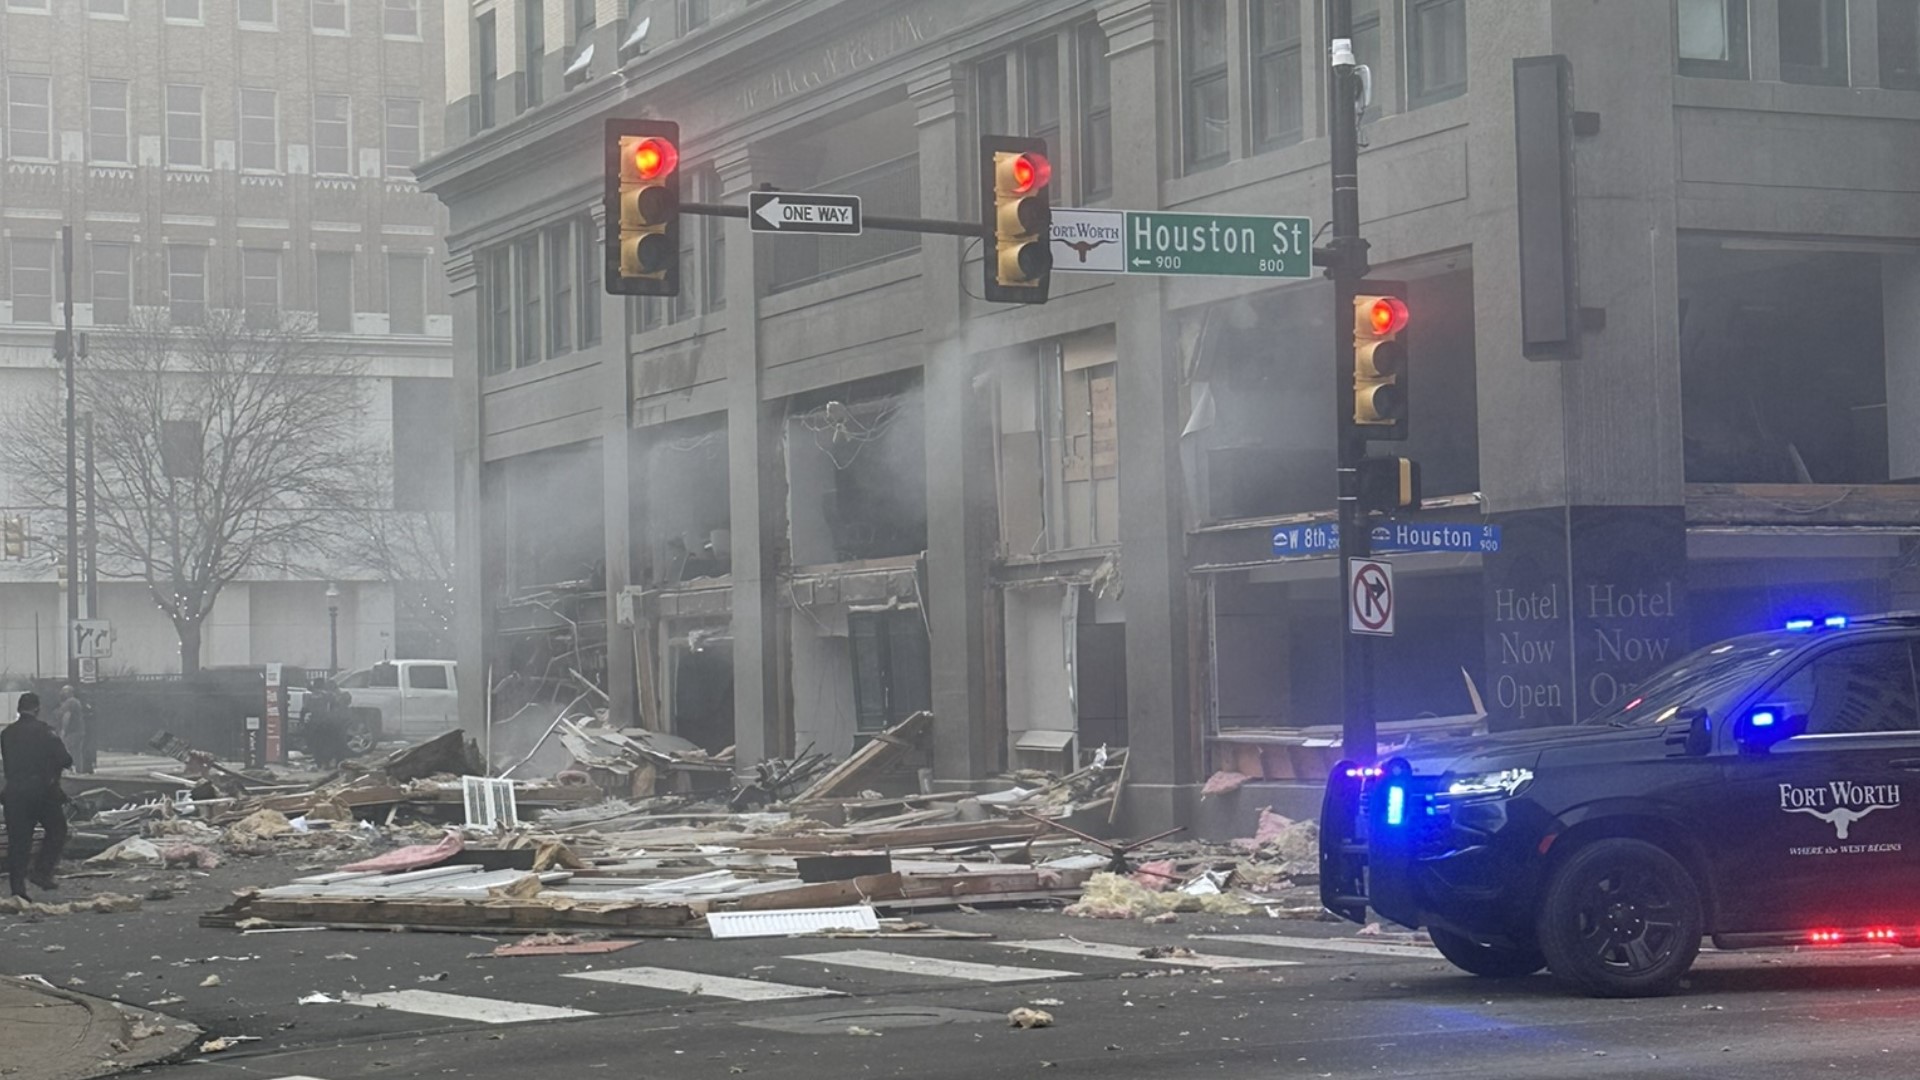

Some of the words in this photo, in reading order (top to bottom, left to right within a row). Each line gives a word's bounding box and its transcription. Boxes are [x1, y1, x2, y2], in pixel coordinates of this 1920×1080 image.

[783, 205, 813, 221] ONE
[818, 206, 848, 222] WAY
[1050, 224, 1075, 238] ORT
[1076, 222, 1119, 239] WORTH
[1134, 216, 1255, 254] Houston
[1272, 221, 1302, 255] St
[1155, 255, 1181, 269] 900
[1258, 259, 1284, 272] 800
[1289, 530, 1299, 549] W
[1304, 527, 1326, 548] 8th
[1396, 526, 1472, 547] Houston
[1496, 584, 1559, 622] Hotel
[1587, 582, 1675, 618] Hotel
[1500, 632, 1555, 664] Now
[1595, 629, 1670, 662] Now
[1497, 675, 1562, 719] Open
[1779, 783, 1827, 807] FORT
[1829, 781, 1900, 805] WORTH
